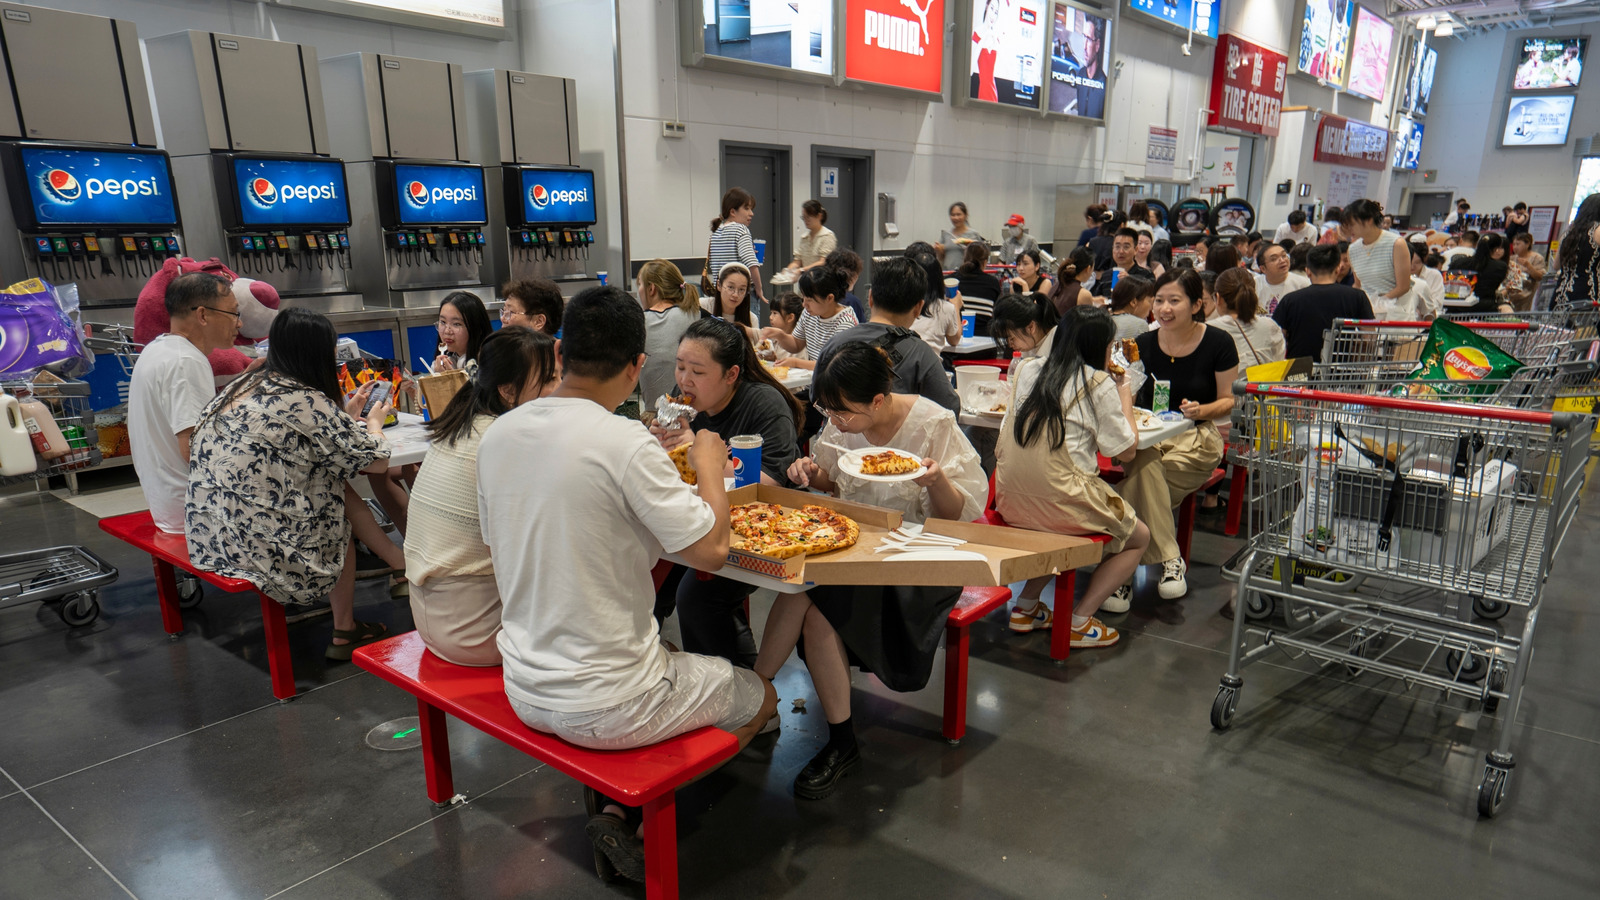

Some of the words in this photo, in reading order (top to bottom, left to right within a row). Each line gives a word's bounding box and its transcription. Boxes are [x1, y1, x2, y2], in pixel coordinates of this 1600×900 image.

[864, 9, 922, 56] PUMA
[1051, 71, 1082, 86] PORSCHE
[1081, 77, 1105, 90] DESIGN
[1223, 84, 1247, 122] TIRE
[1245, 90, 1281, 129] CENTER
[85, 176, 160, 200] pepsi
[280, 181, 336, 204] pepsi
[431, 185, 476, 205] pepsi
[550, 187, 588, 206] pepsi
[1445, 352, 1469, 370] Lay's
